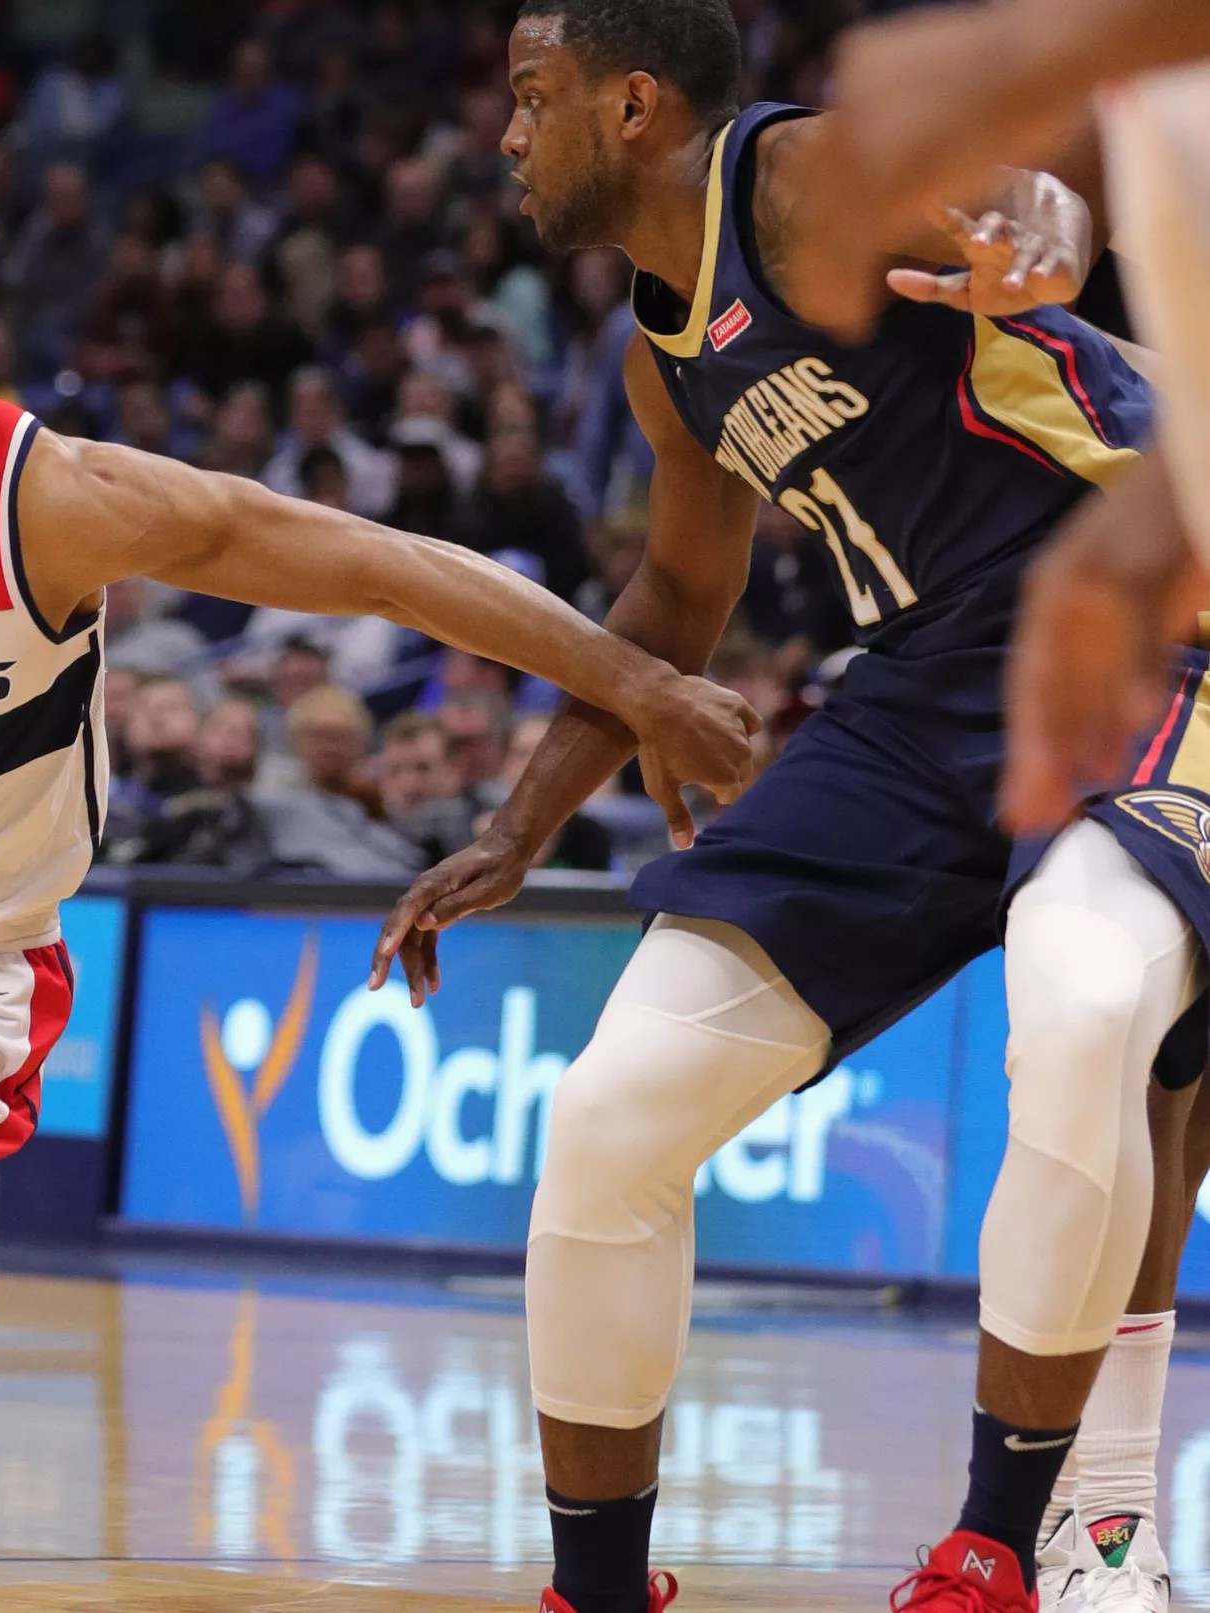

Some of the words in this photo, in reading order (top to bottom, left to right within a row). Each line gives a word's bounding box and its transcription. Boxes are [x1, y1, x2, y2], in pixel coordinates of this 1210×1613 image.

[724, 356, 869, 483] ORLEANS
[778, 467, 918, 627] 21
[317, 978, 854, 1203] Ocher
